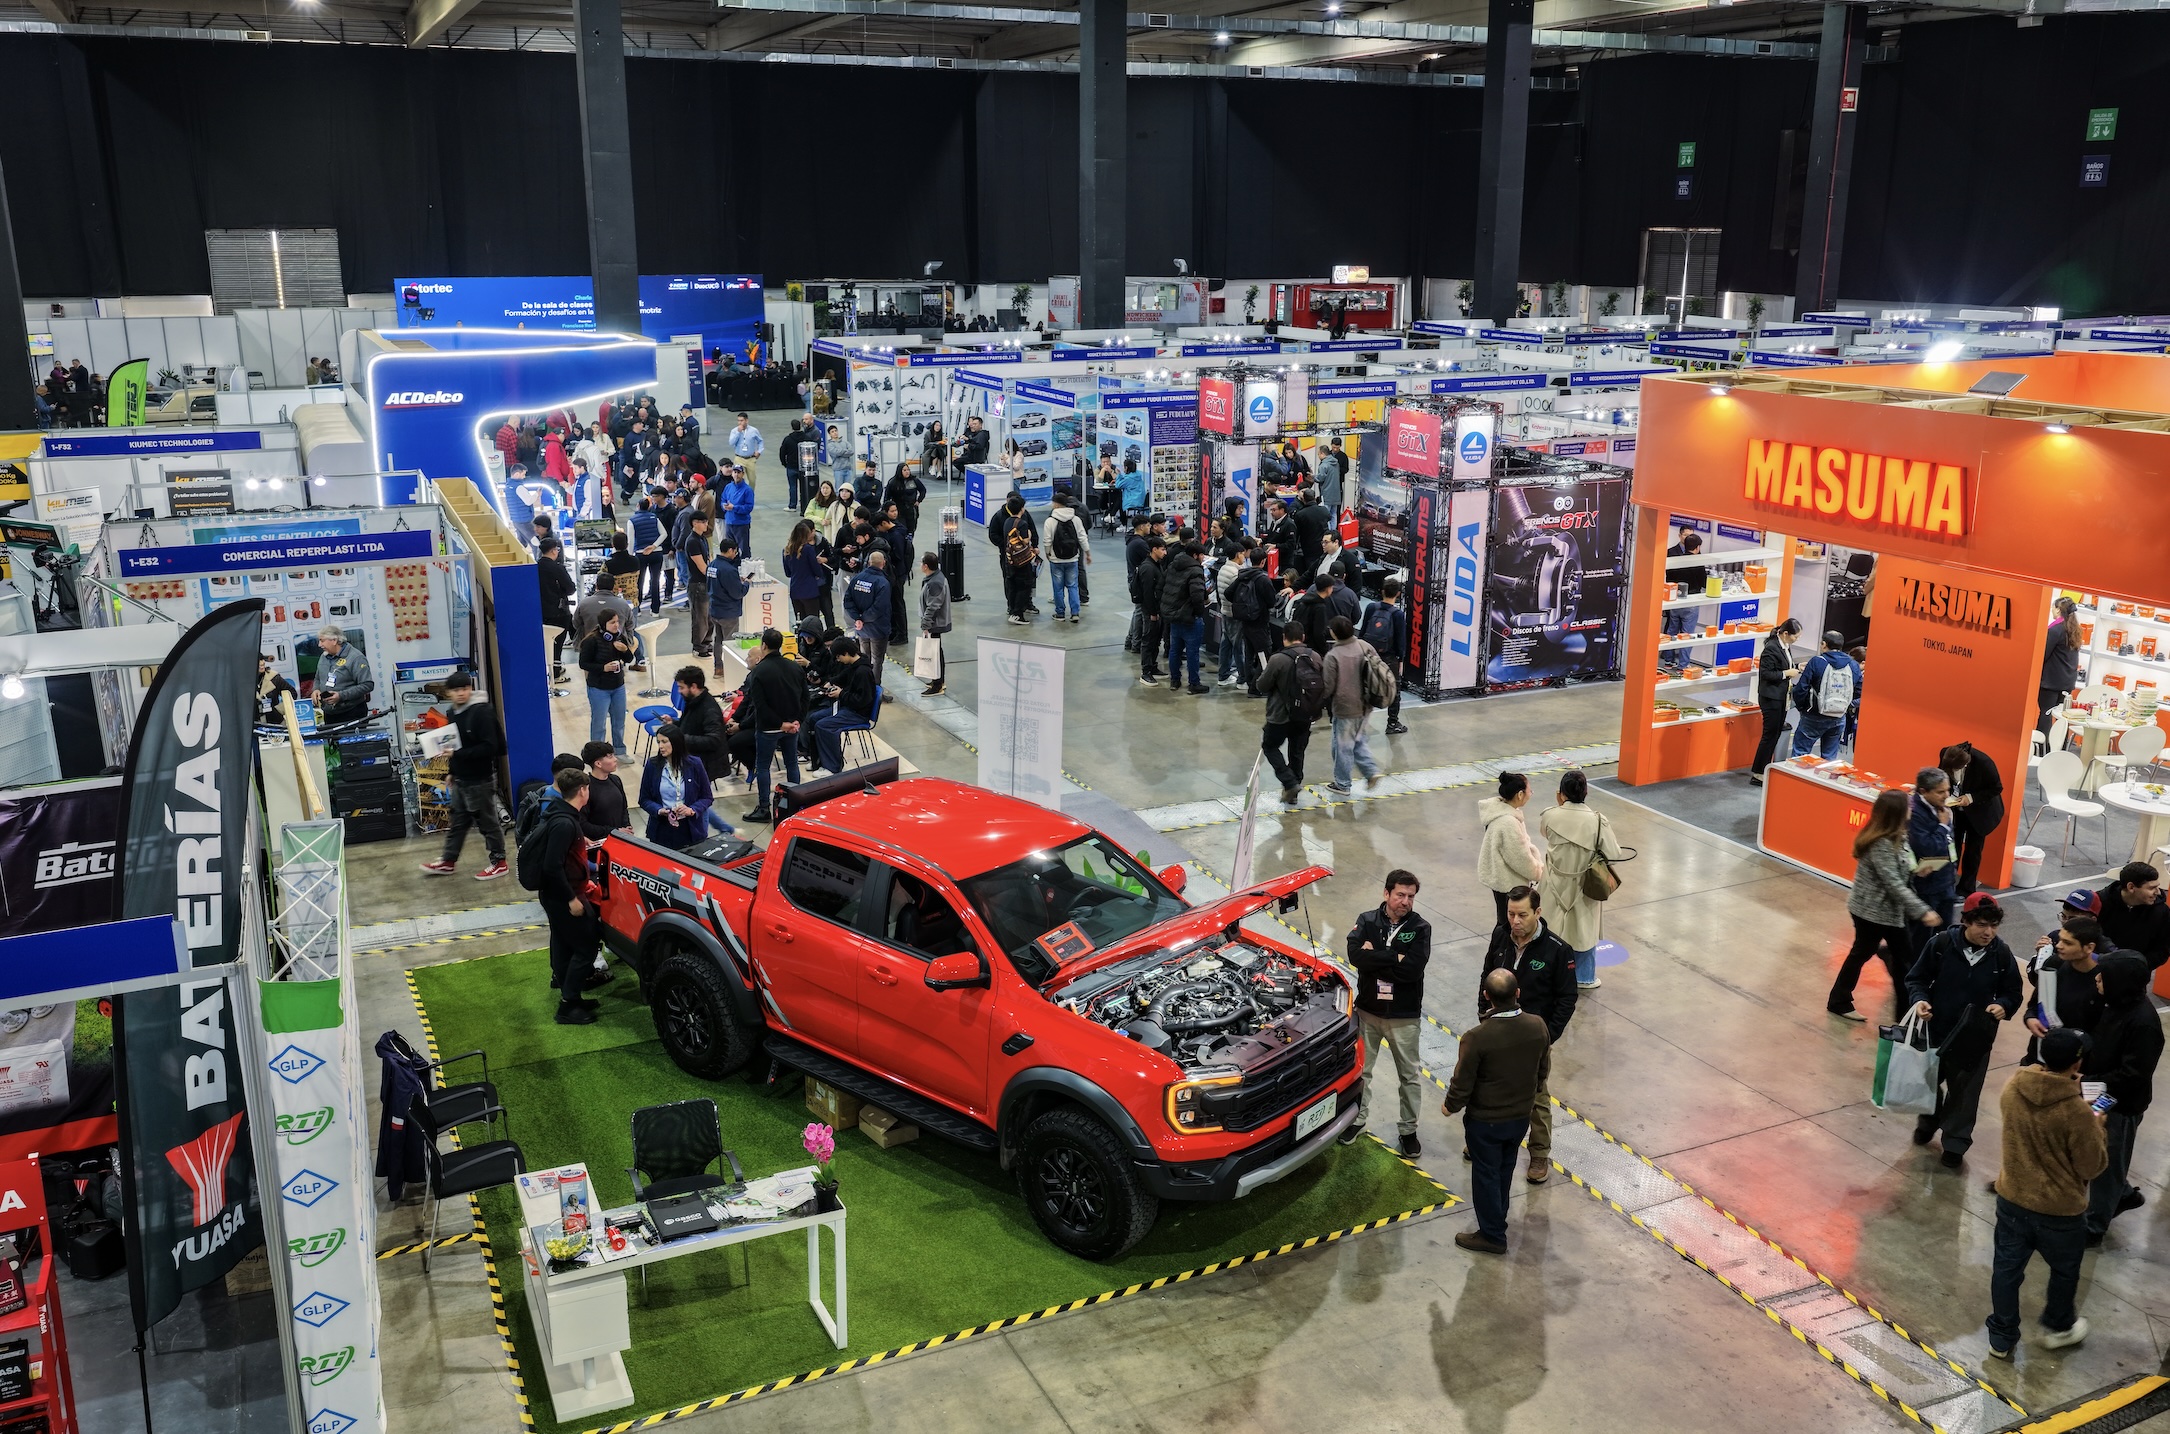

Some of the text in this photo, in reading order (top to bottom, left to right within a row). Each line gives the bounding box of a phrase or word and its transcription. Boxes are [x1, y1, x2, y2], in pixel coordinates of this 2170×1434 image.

[504, 309, 541, 317] Formación
[384, 390, 464, 405] ACDelco
[1204, 396, 1226, 414] GTX
[129, 440, 158, 448] KIUMEC
[158, 438, 214, 447] TECHNOLOGIES
[1398, 430, 1430, 453] GTX
[1744, 438, 1967, 537] MASUMA
[48, 496, 93, 511] KIUMEC
[1560, 511, 1599, 529] GTX
[129, 543, 385, 567] 1-E32 COMERCIAL REPERPLAST LTDA
[1410, 496, 1430, 668] BRAKE DRUMS
[1450, 522, 1480, 656] LUDA
[1896, 576, 2010, 631] MASUMA
[1512, 624, 1559, 635] Discos de freno
[1570, 618, 1607, 627] CLASSIC
[1923, 637, 1973, 658] TOKYO, JAPAN
[610, 861, 672, 908] RAPTOR
[164, 691, 228, 1112] BATERÍAS
[280, 1059, 309, 1072] GLP
[292, 1182, 321, 1195] GLP
[171, 1204, 246, 1270] YUASA
[303, 1303, 332, 1317] GLP
[38, 1312, 48, 1335] YUASA
[312, 1420, 340, 1434] GLP
